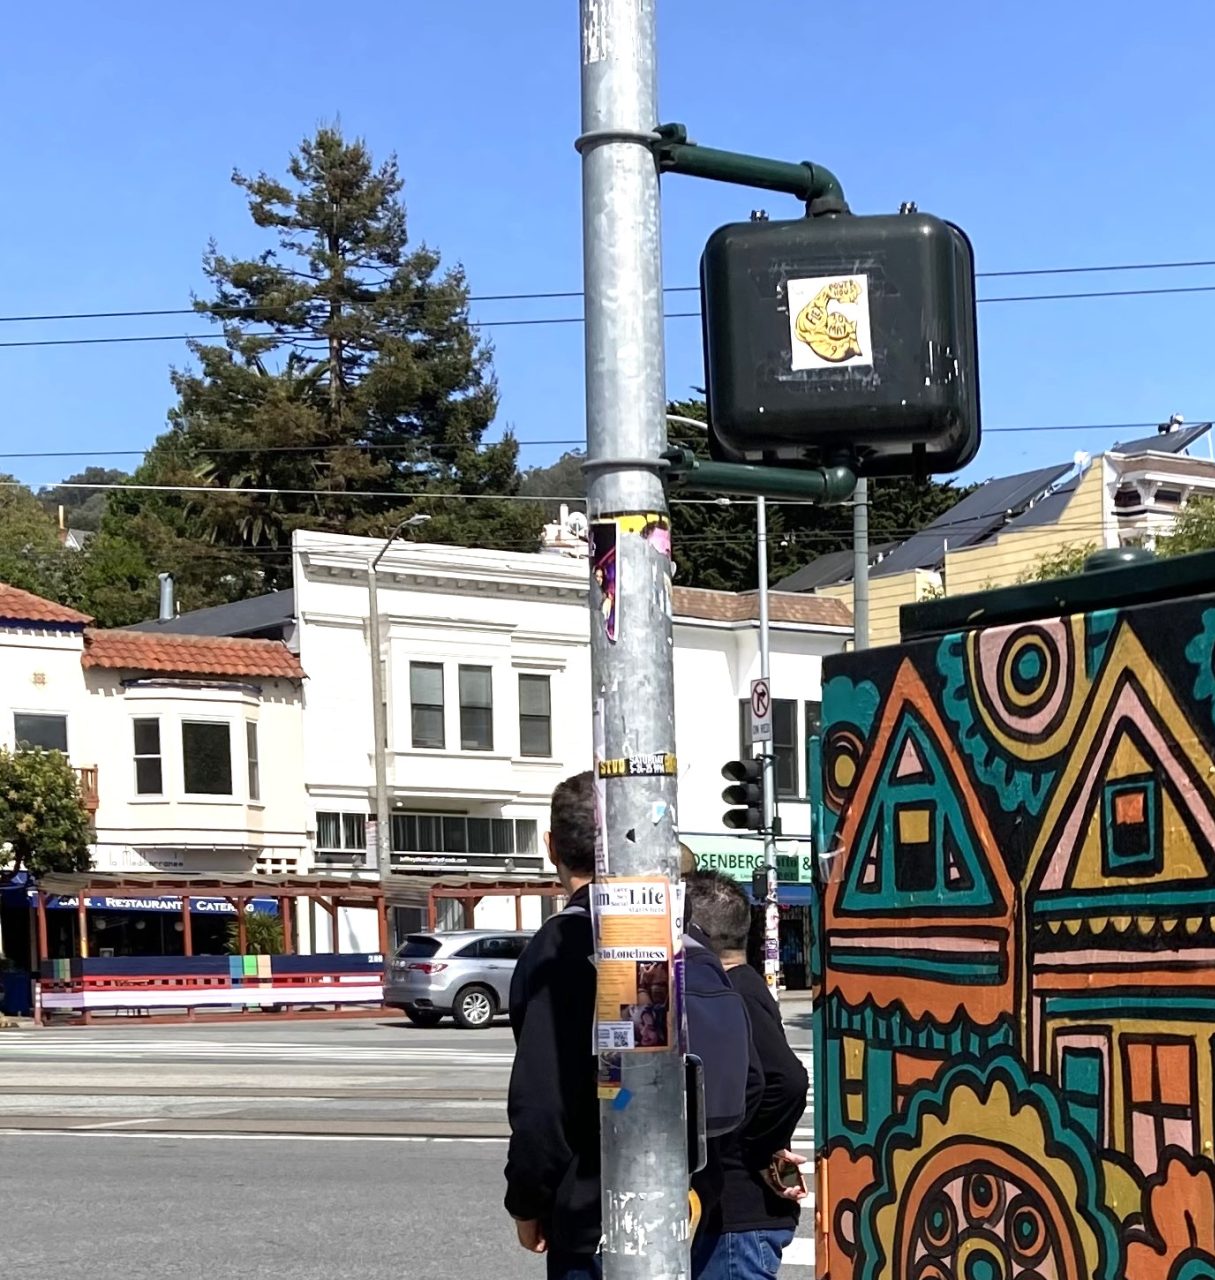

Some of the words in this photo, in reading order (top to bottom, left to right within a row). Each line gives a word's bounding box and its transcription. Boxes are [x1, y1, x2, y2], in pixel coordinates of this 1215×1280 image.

[805, 302, 824, 326] FLEX
[829, 323, 847, 336] MAY
[600, 758, 625, 775] STUD
[629, 887, 663, 904] Life
[196, 901, 255, 914] CATERG
